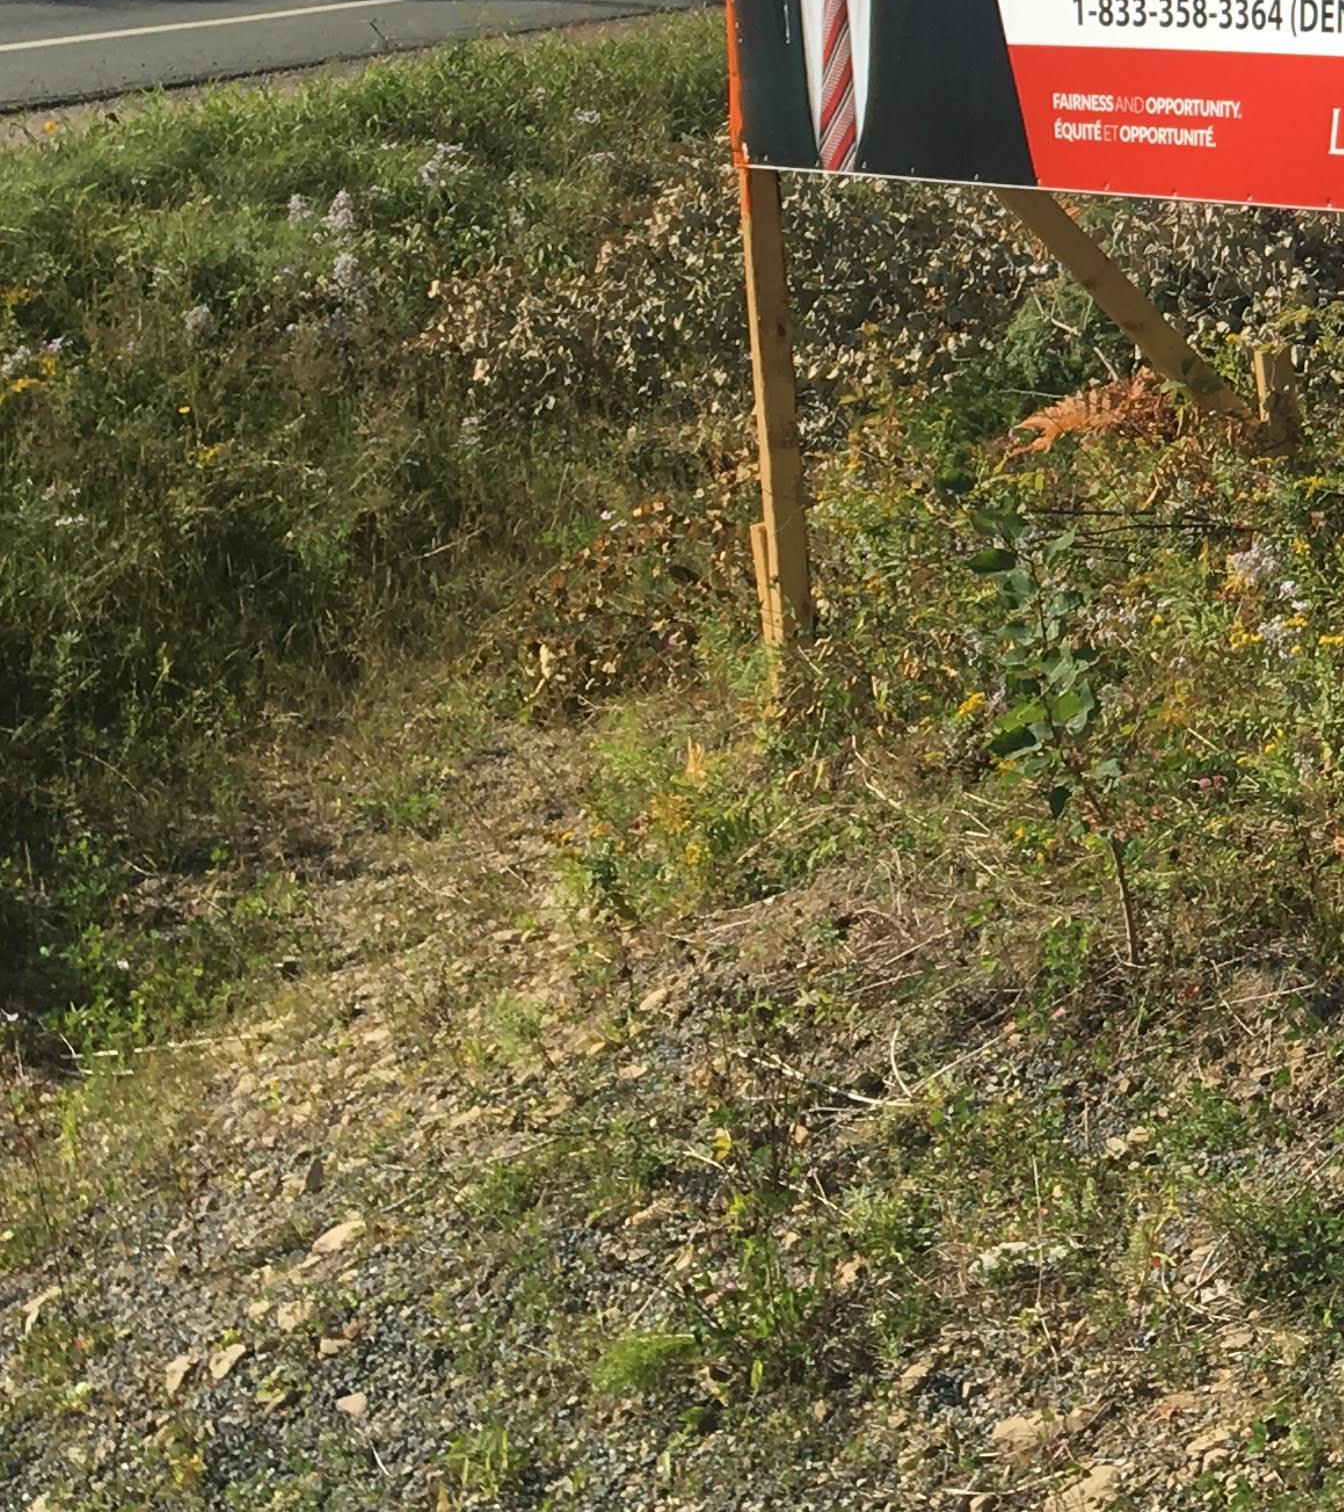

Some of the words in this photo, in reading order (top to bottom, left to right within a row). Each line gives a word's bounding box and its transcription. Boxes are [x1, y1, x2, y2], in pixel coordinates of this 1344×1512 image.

[1052, 92, 1114, 112] FAIRNESS
[1115, 96, 1145, 114] AND
[1054, 118, 1102, 143] ÉQUITÉ
[1103, 124, 1119, 142] ET
